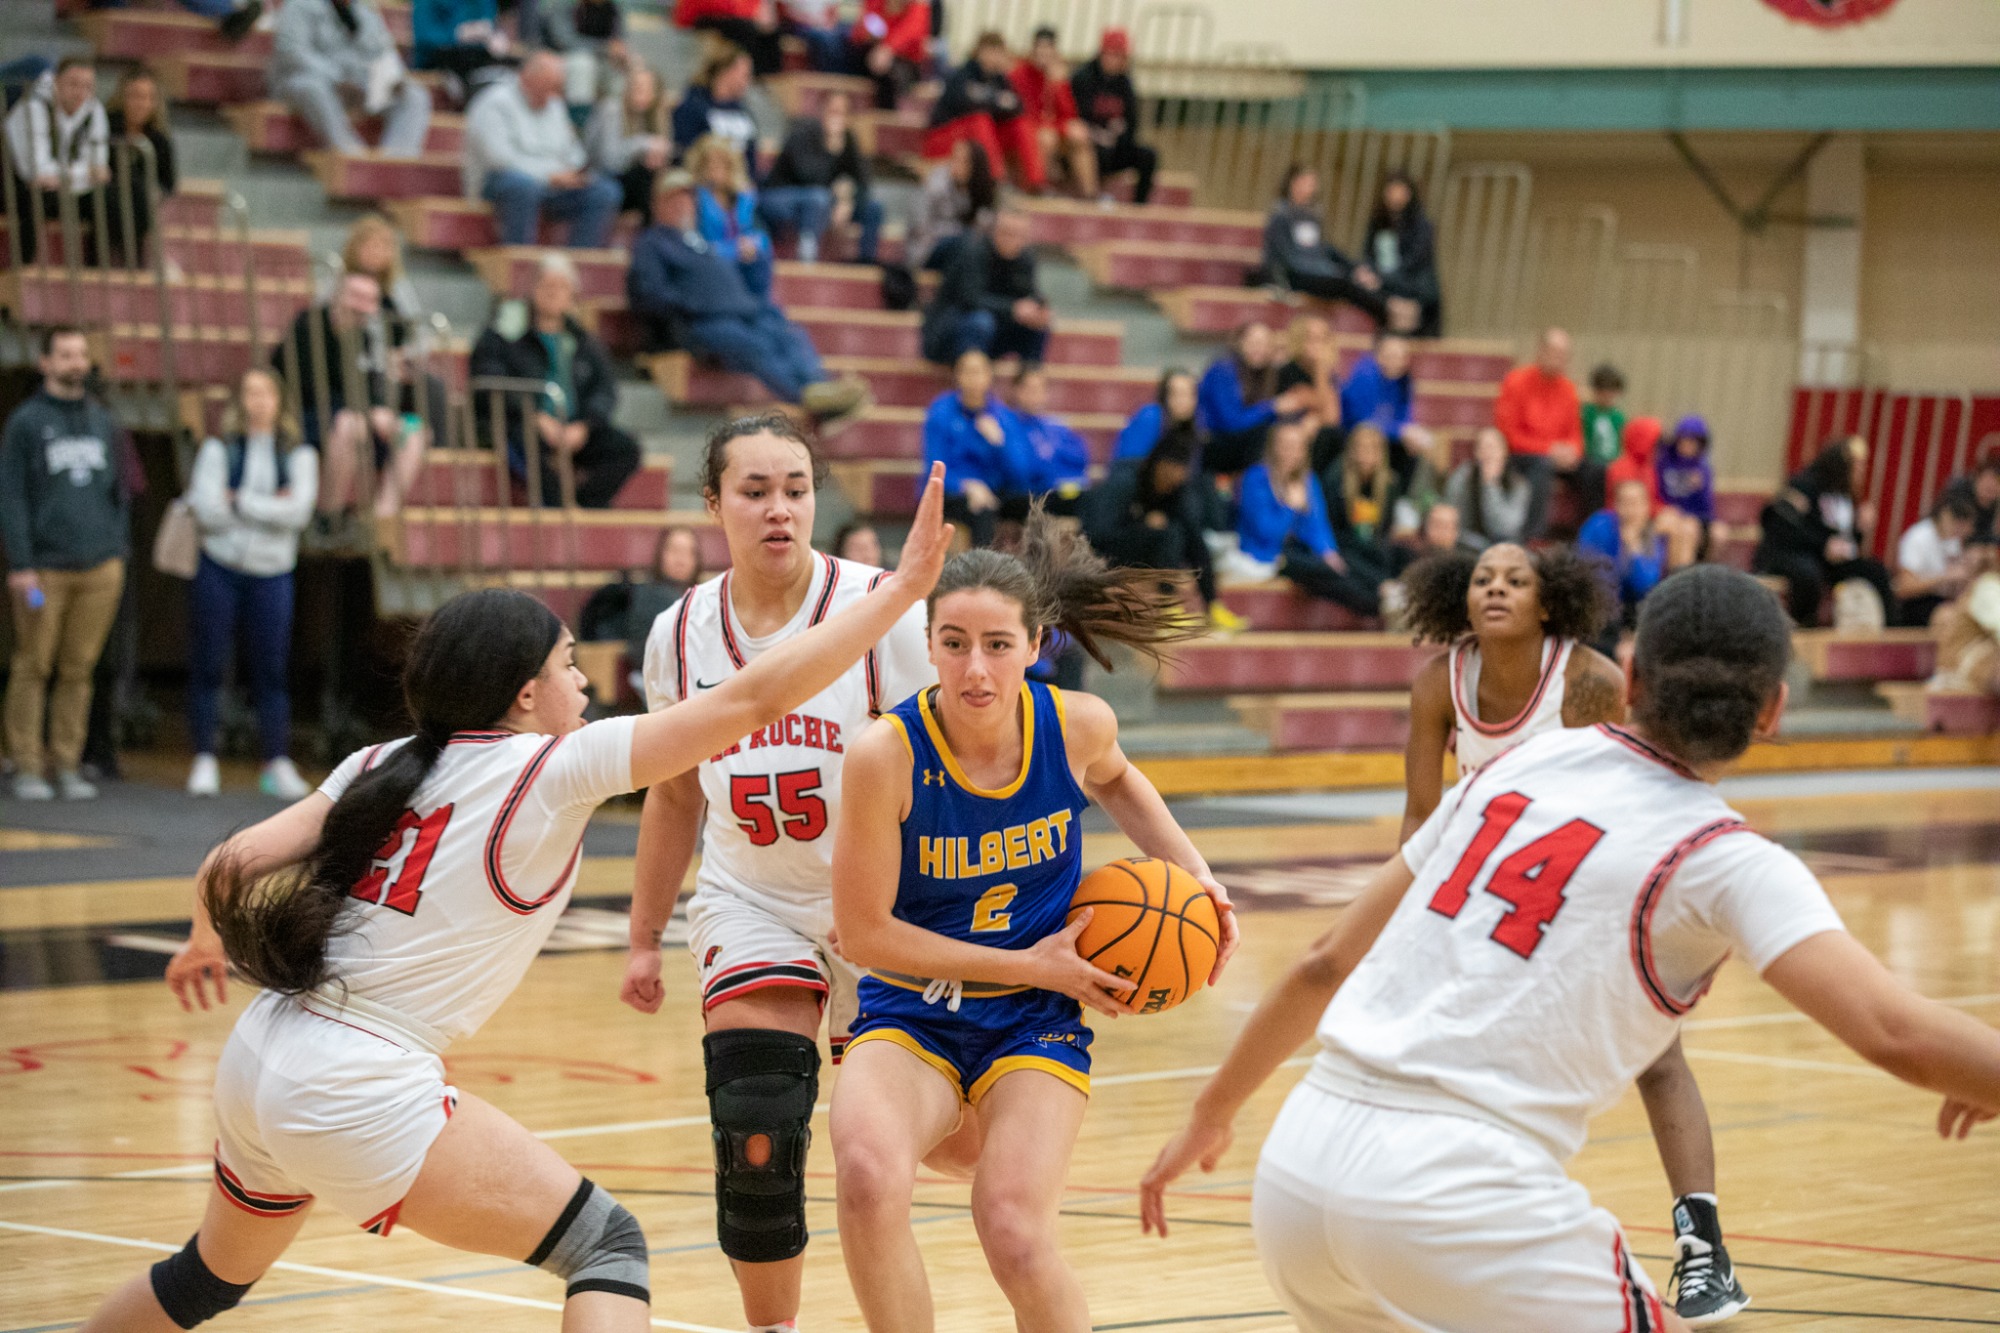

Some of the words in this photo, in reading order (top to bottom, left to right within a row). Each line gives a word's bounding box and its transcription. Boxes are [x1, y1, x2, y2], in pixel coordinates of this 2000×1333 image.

[730, 767, 828, 847] 55
[919, 808, 1073, 880] HILBERT
[969, 882, 1019, 932] 2
[1427, 790, 1607, 961] 14
